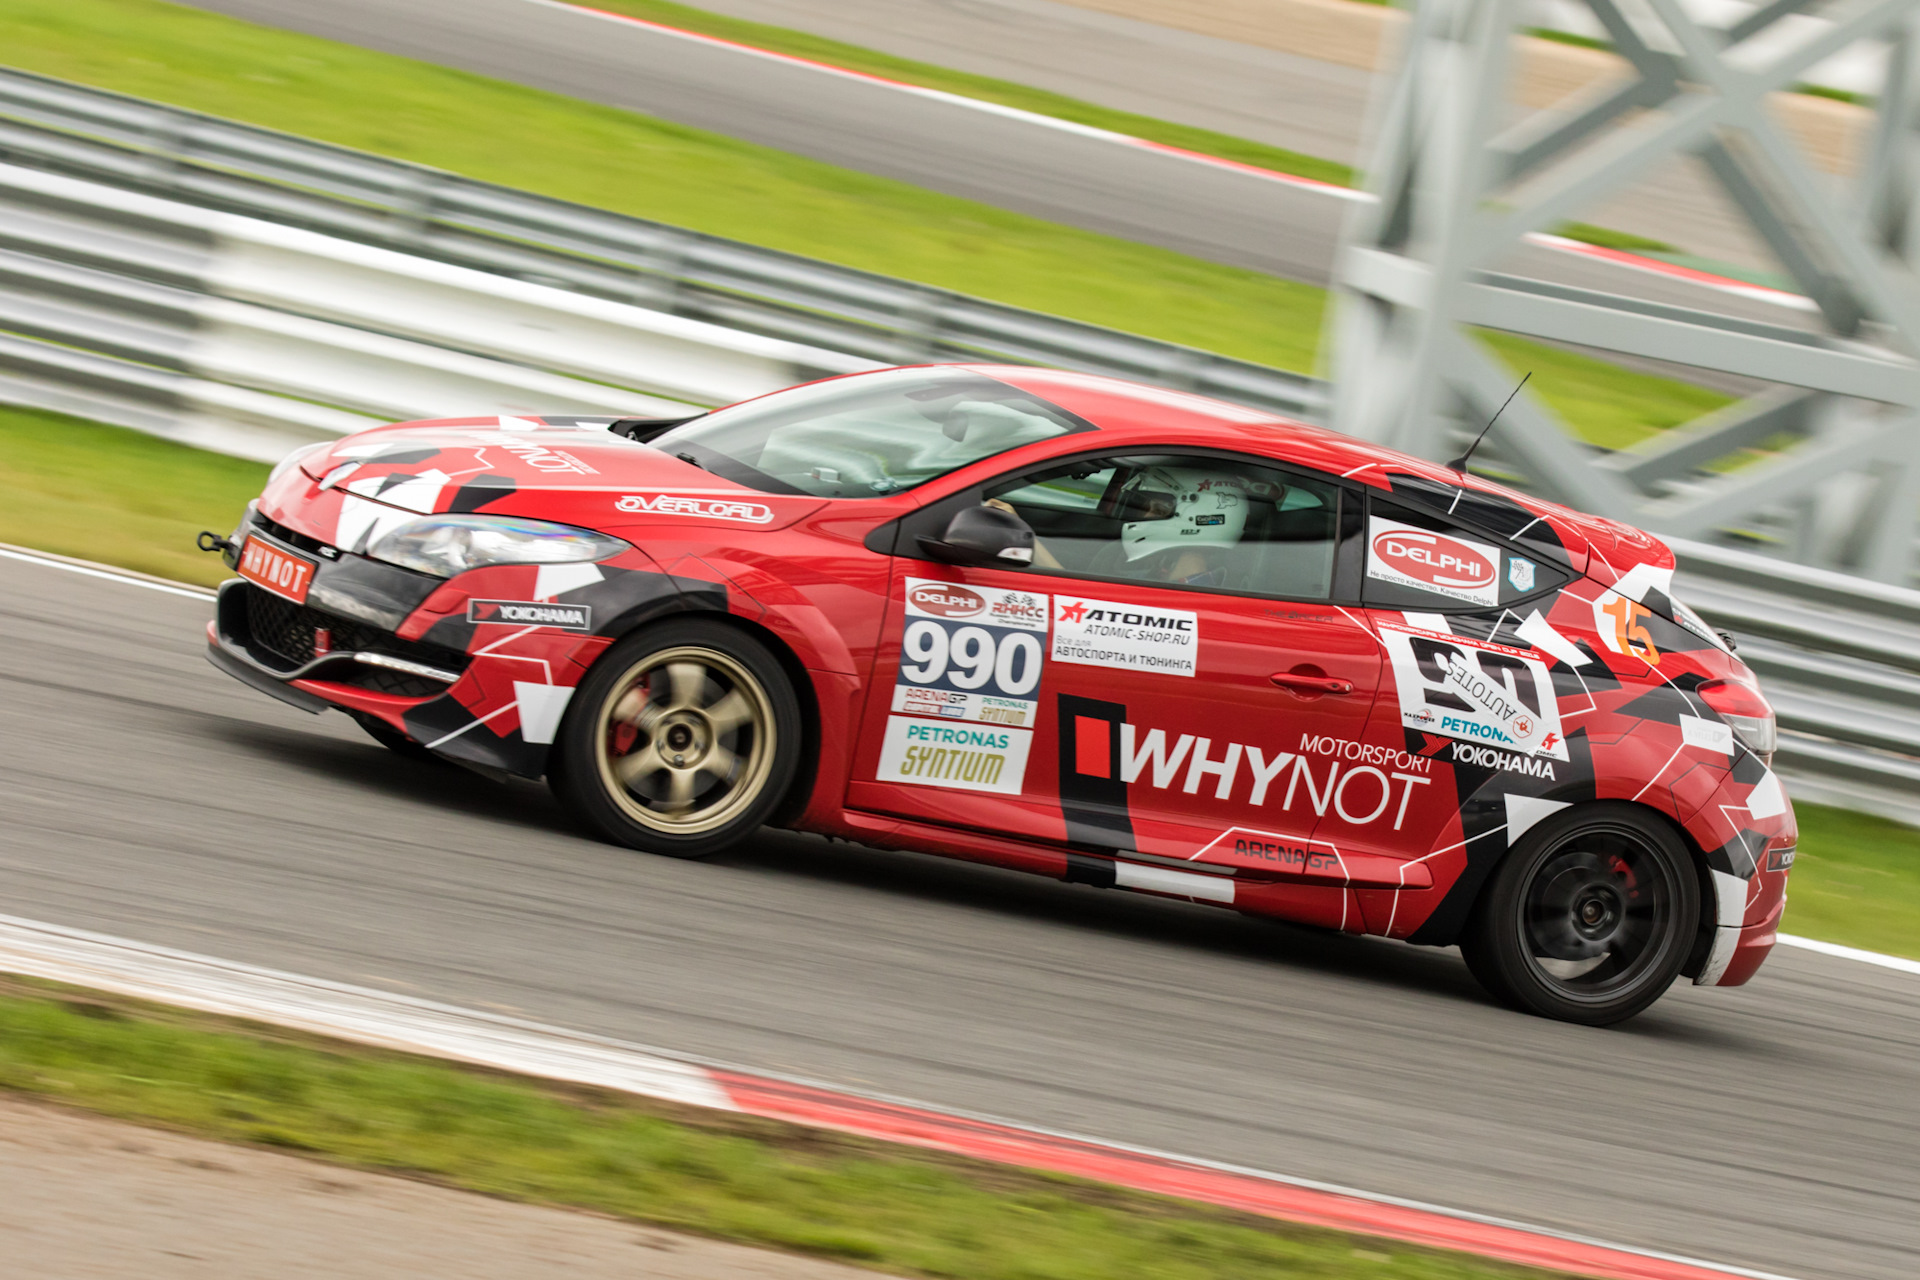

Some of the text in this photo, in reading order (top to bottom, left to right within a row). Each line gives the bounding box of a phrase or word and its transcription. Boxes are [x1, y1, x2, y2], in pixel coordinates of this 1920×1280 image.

[616, 494, 774, 523] OVERLOAD
[243, 541, 307, 593] WHYNOT
[1386, 541, 1481, 577] DELPHI
[1381, 574, 1405, 584] просто
[915, 591, 978, 609] DELPHI
[499, 605, 585, 624] YOKOHAMA
[1085, 610, 1193, 632] ATOMIC
[1056, 635, 1092, 647] Все для
[1084, 624, 1190, 645] ATOMIC-SHOP.RU
[1603, 596, 1660, 665] 15
[901, 620, 1043, 696] 990
[1055, 646, 1192, 670] АВТОСПОРТА И ТЮНИНГА
[979, 707, 1027, 725] SYNTIUM
[982, 697, 1028, 709] PETRONAS
[907, 725, 1010, 749] PETRONAS
[1441, 716, 1515, 744] PETRONA
[900, 746, 1005, 784] SYNTIUM
[1300, 733, 1432, 774] MOTORSPORT
[1451, 742, 1556, 781] YOKOHAMA
[1235, 839, 1339, 870] ARENAGP
